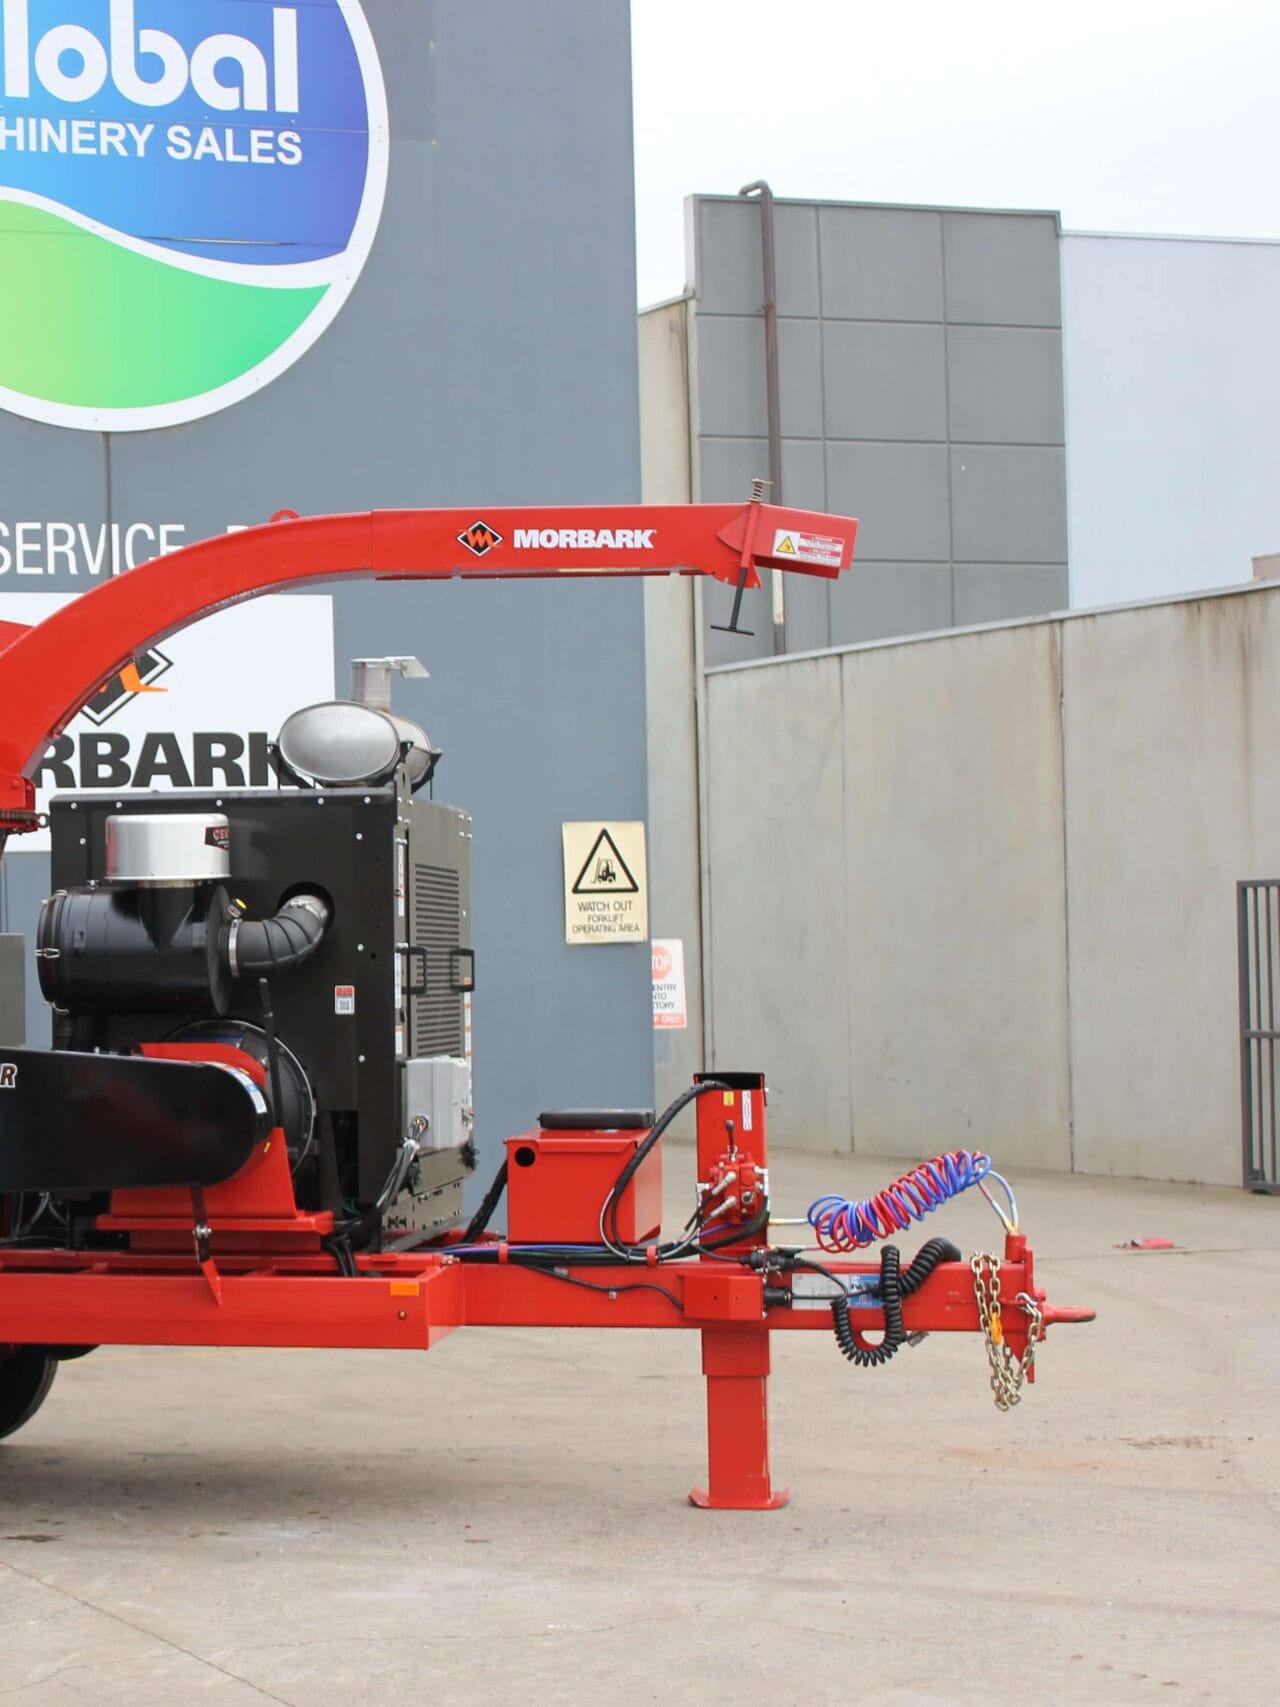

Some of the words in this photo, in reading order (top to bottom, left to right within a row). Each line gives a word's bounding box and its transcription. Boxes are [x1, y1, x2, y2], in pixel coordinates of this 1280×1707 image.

[166, 125, 303, 166] SALES
[513, 529, 654, 548] MORBARK
[577, 901, 610, 912] WATCH
[613, 900, 633, 911] OUT
[587, 914, 624, 923] FORKLIFT
[572, 924, 616, 933] OPERATING
[618, 923, 640, 932] AREA
[652, 954, 672, 971] TOP
